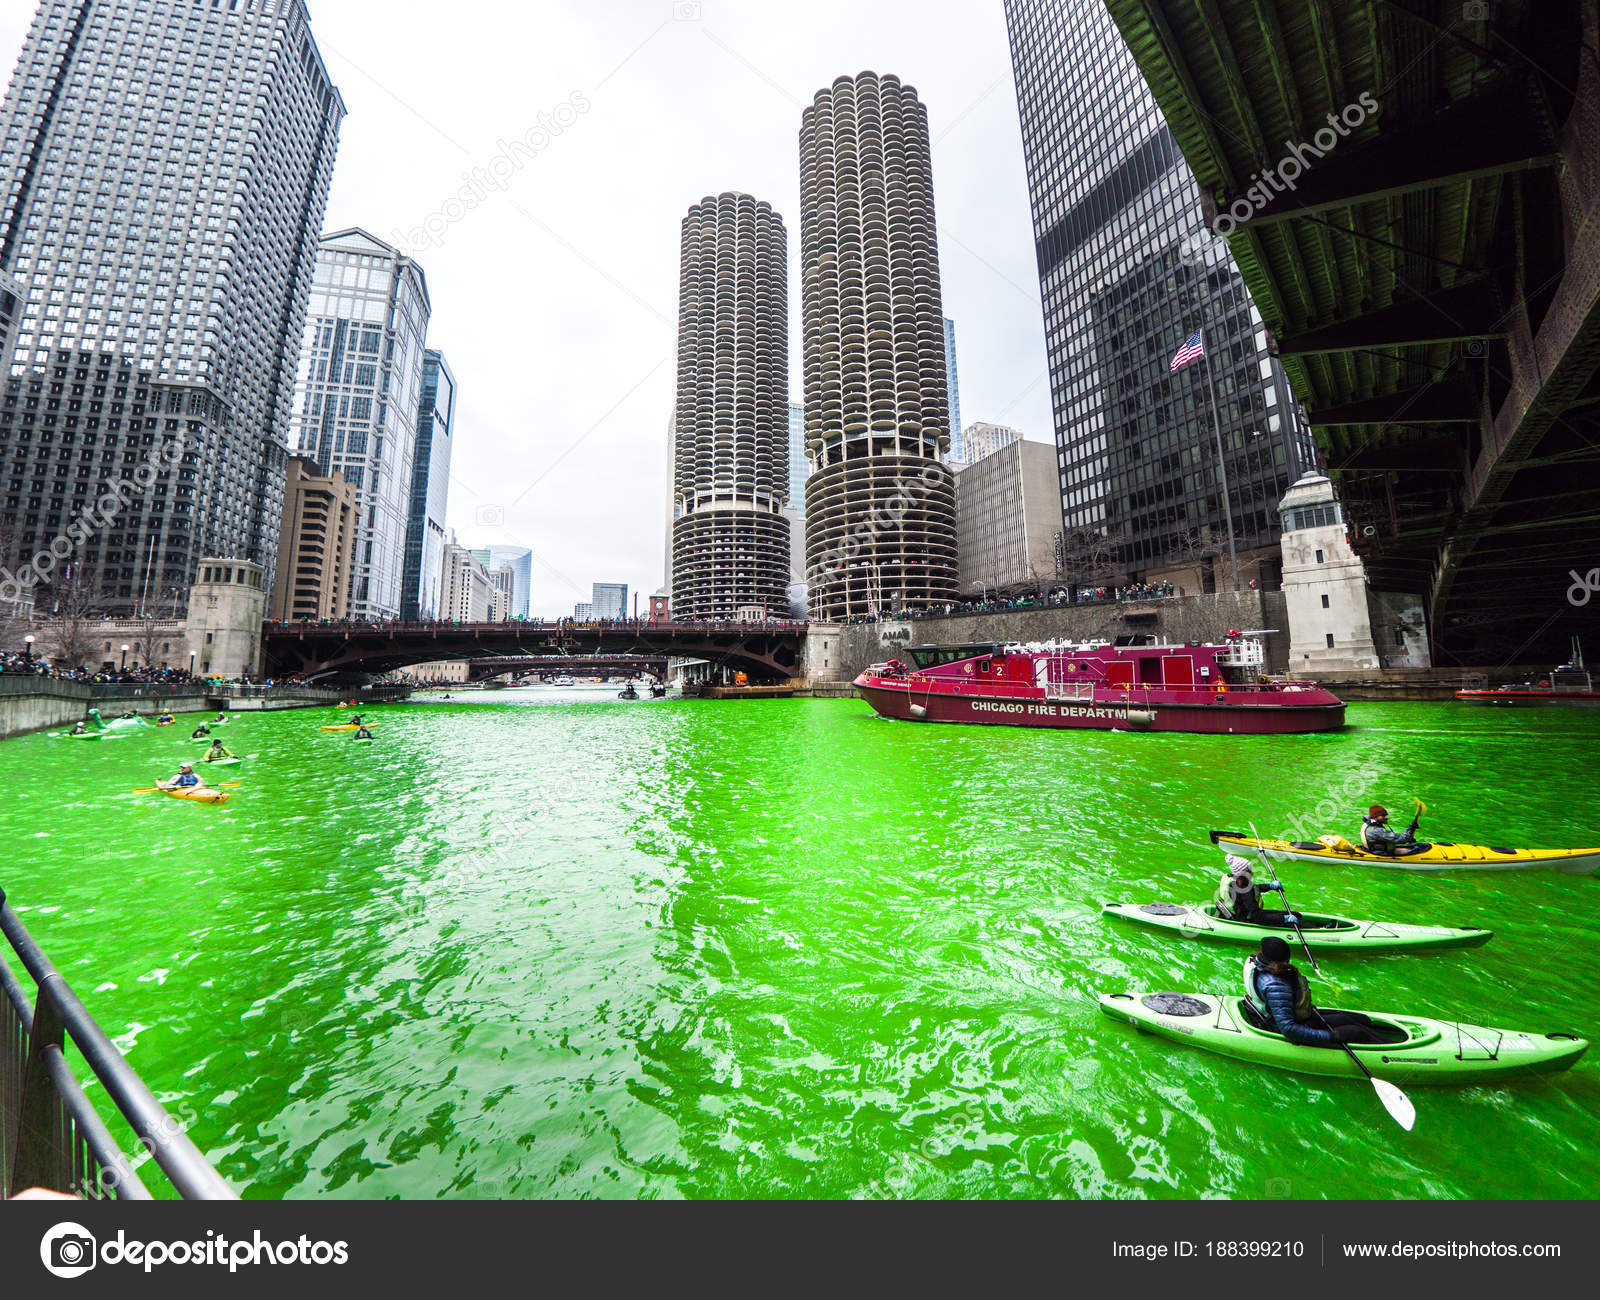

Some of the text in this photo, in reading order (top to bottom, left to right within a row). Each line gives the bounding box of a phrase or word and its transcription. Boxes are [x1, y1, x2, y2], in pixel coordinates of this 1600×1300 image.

[996, 667, 1003, 676] 2
[971, 701, 1158, 721] CHICAGO FIRE DEPARTMT
